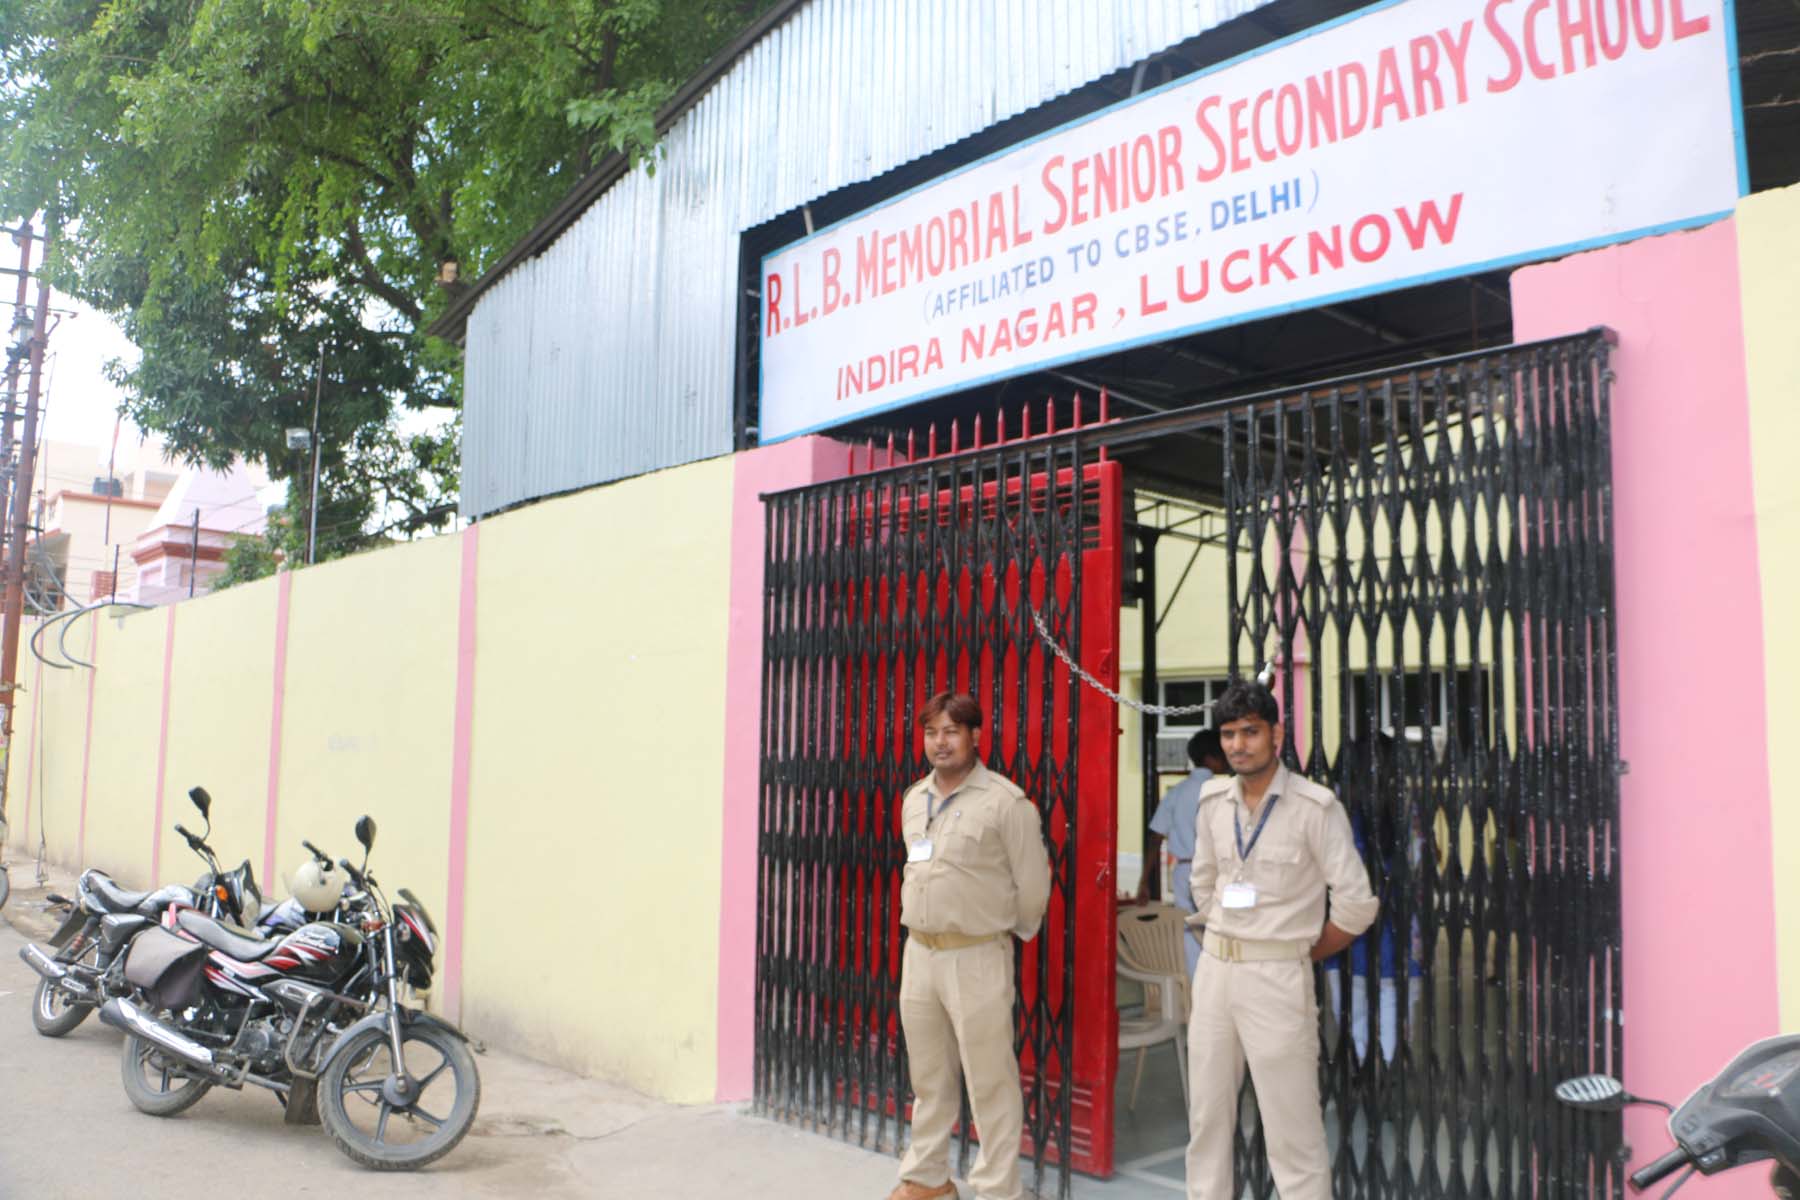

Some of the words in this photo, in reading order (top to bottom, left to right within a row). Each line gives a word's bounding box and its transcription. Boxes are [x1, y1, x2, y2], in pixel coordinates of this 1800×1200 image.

[856, 185, 1033, 304] MEMORIAL
[1042, 126, 1185, 234] SENIOR
[1195, 20, 1473, 183] SECONDARY
[1484, 0, 1711, 93] SCHOOL
[923, 256, 1056, 325] (AFFILIATED
[1067, 238, 1102, 274] TO
[1210, 168, 1320, 232] DELHI)
[837, 338, 944, 400] INDIRA
[1140, 193, 1463, 316] LUCKNOW
